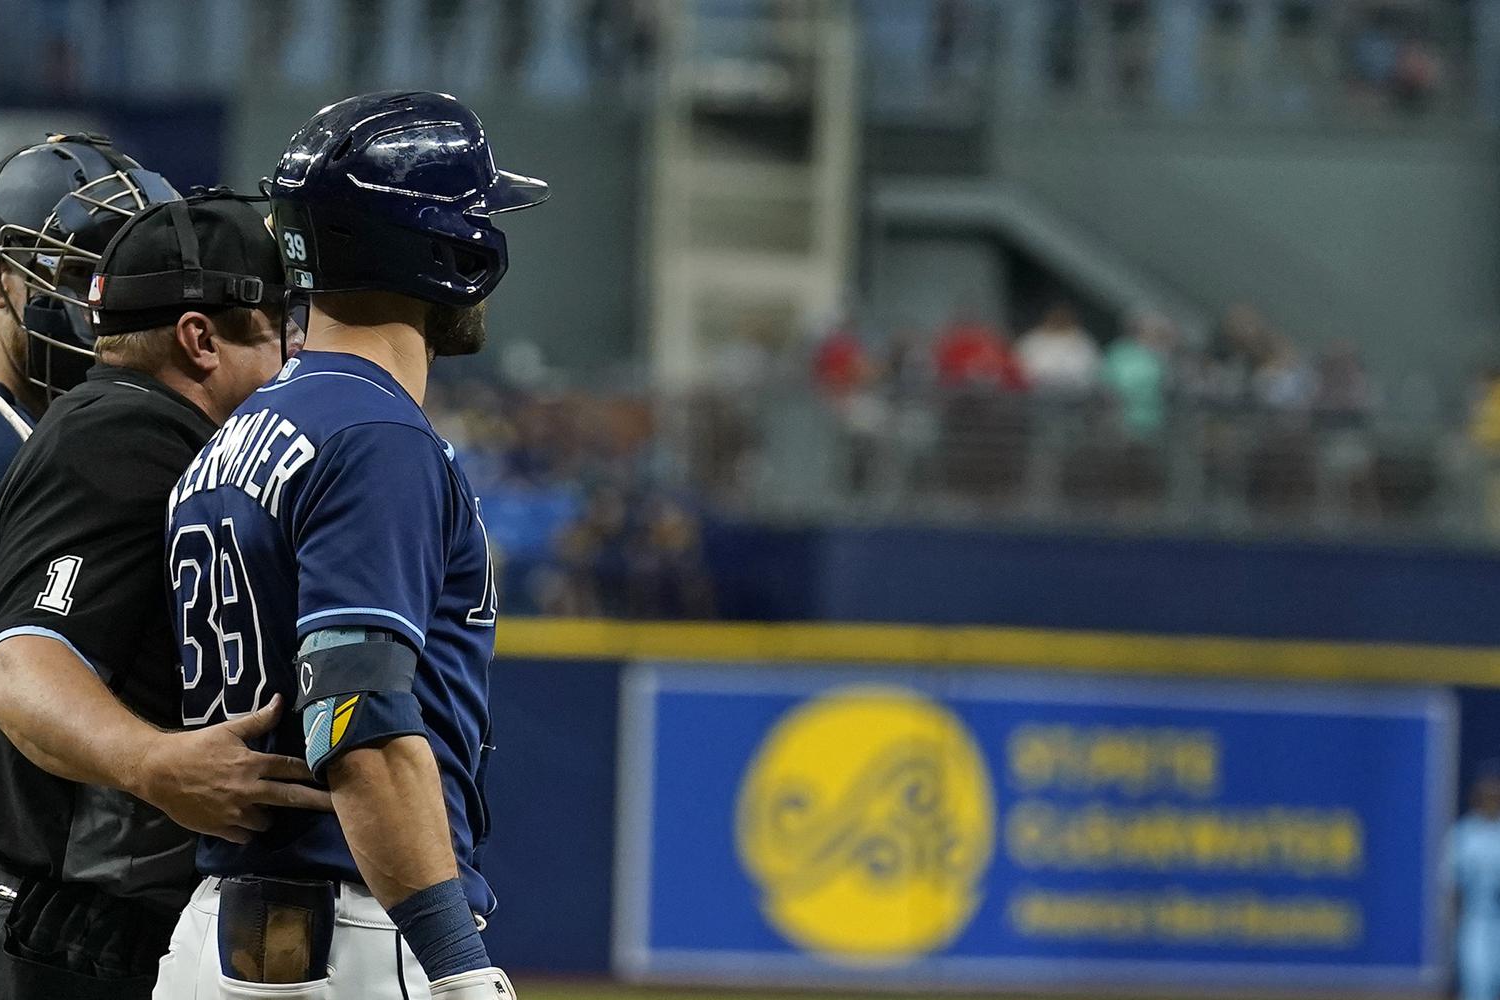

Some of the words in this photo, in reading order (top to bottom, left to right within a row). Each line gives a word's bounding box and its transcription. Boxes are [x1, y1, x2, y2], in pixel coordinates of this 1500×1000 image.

[283, 231, 307, 261] 39
[34, 555, 83, 616] 1
[170, 518, 267, 726] 39
